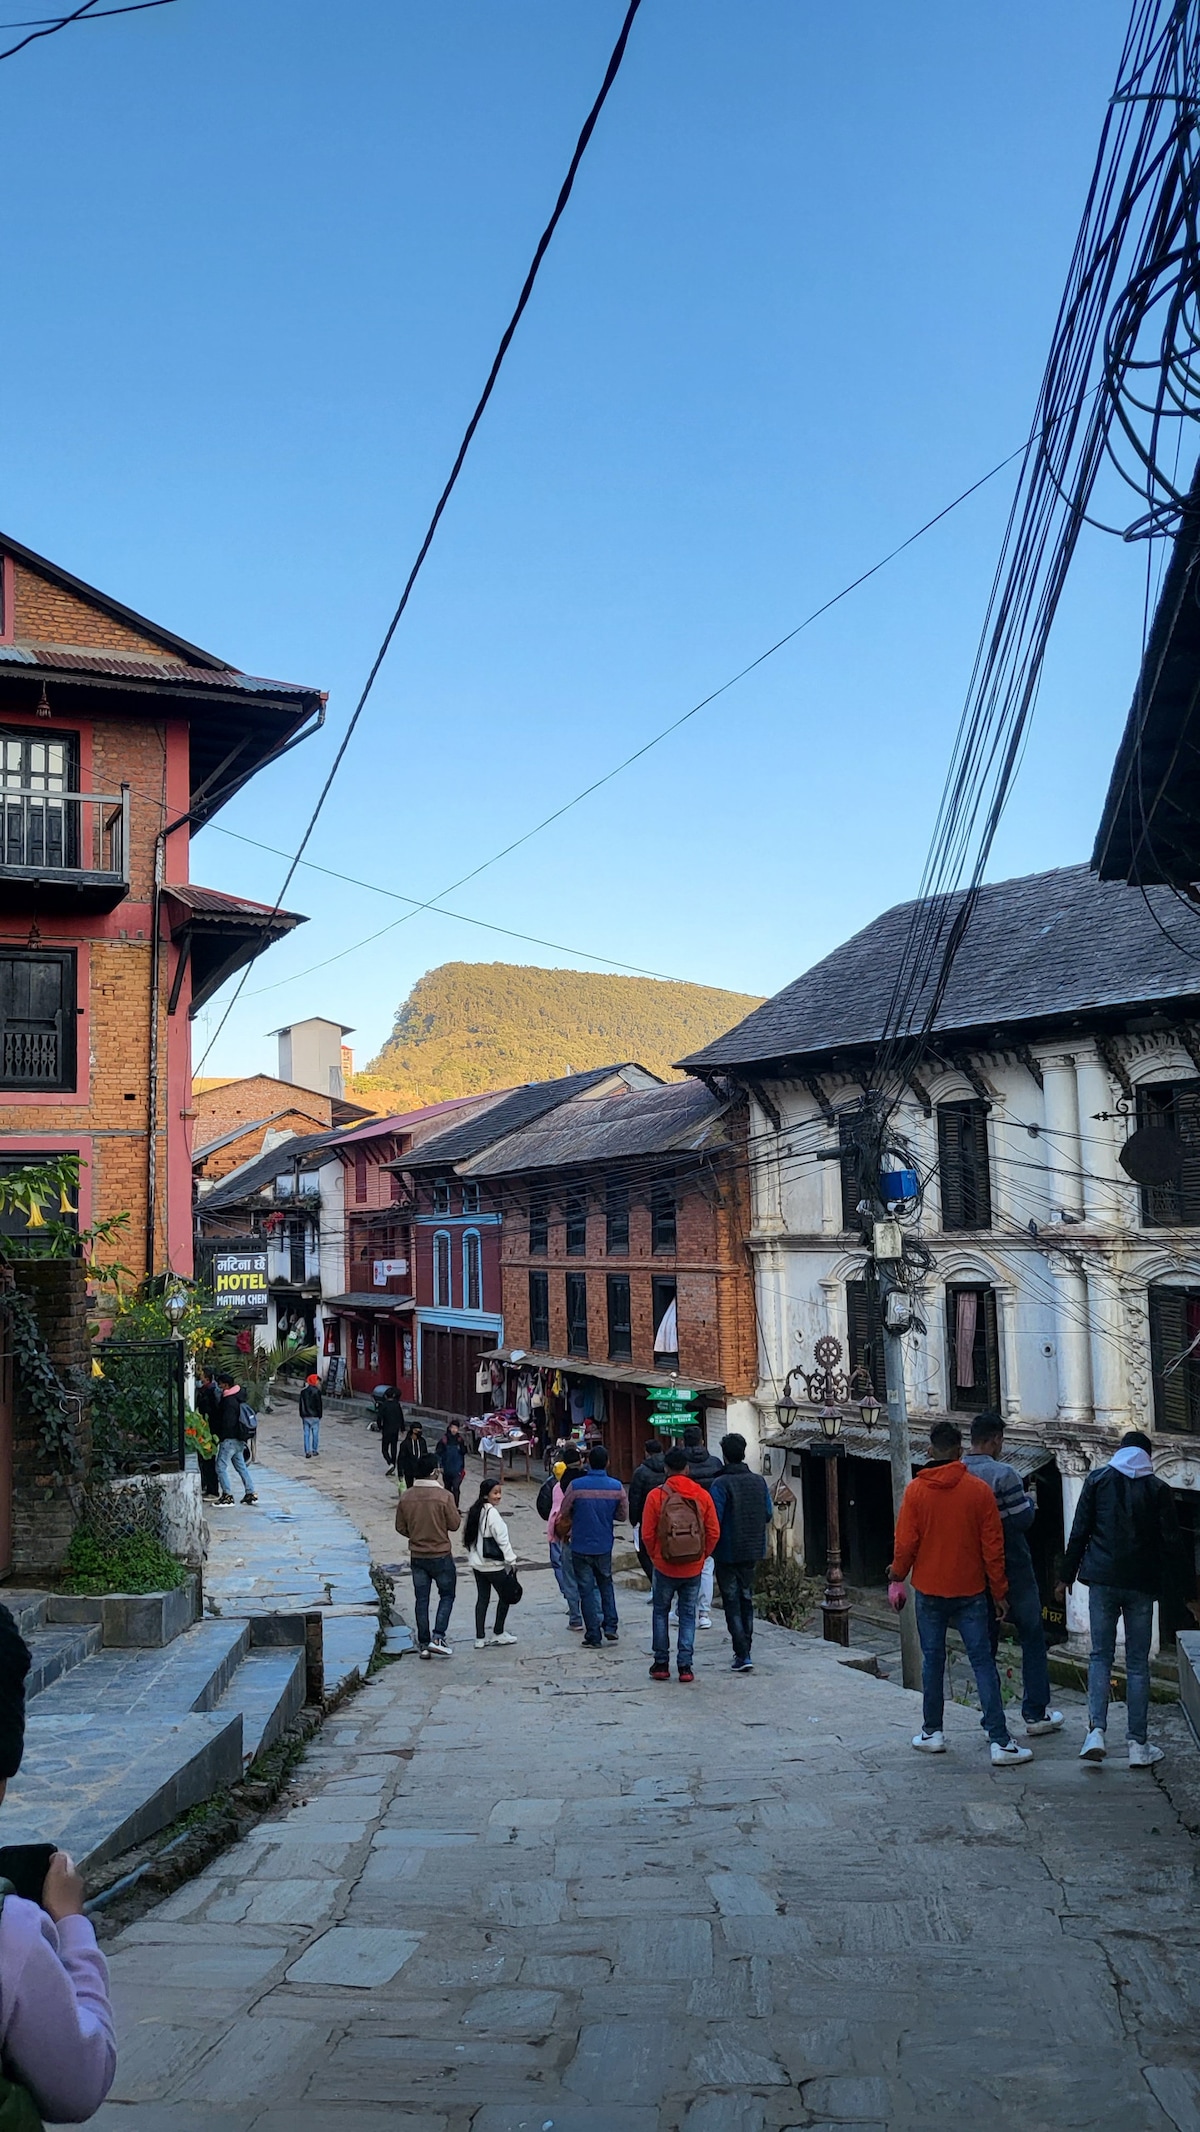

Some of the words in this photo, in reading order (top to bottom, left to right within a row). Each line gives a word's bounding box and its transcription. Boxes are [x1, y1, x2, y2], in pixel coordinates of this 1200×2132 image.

[217, 1256, 251, 1271] मटिना
[217, 1274, 267, 1291] HOTEL
[216, 1294, 246, 1306] MATINA
[247, 1294, 267, 1305] CHEN
